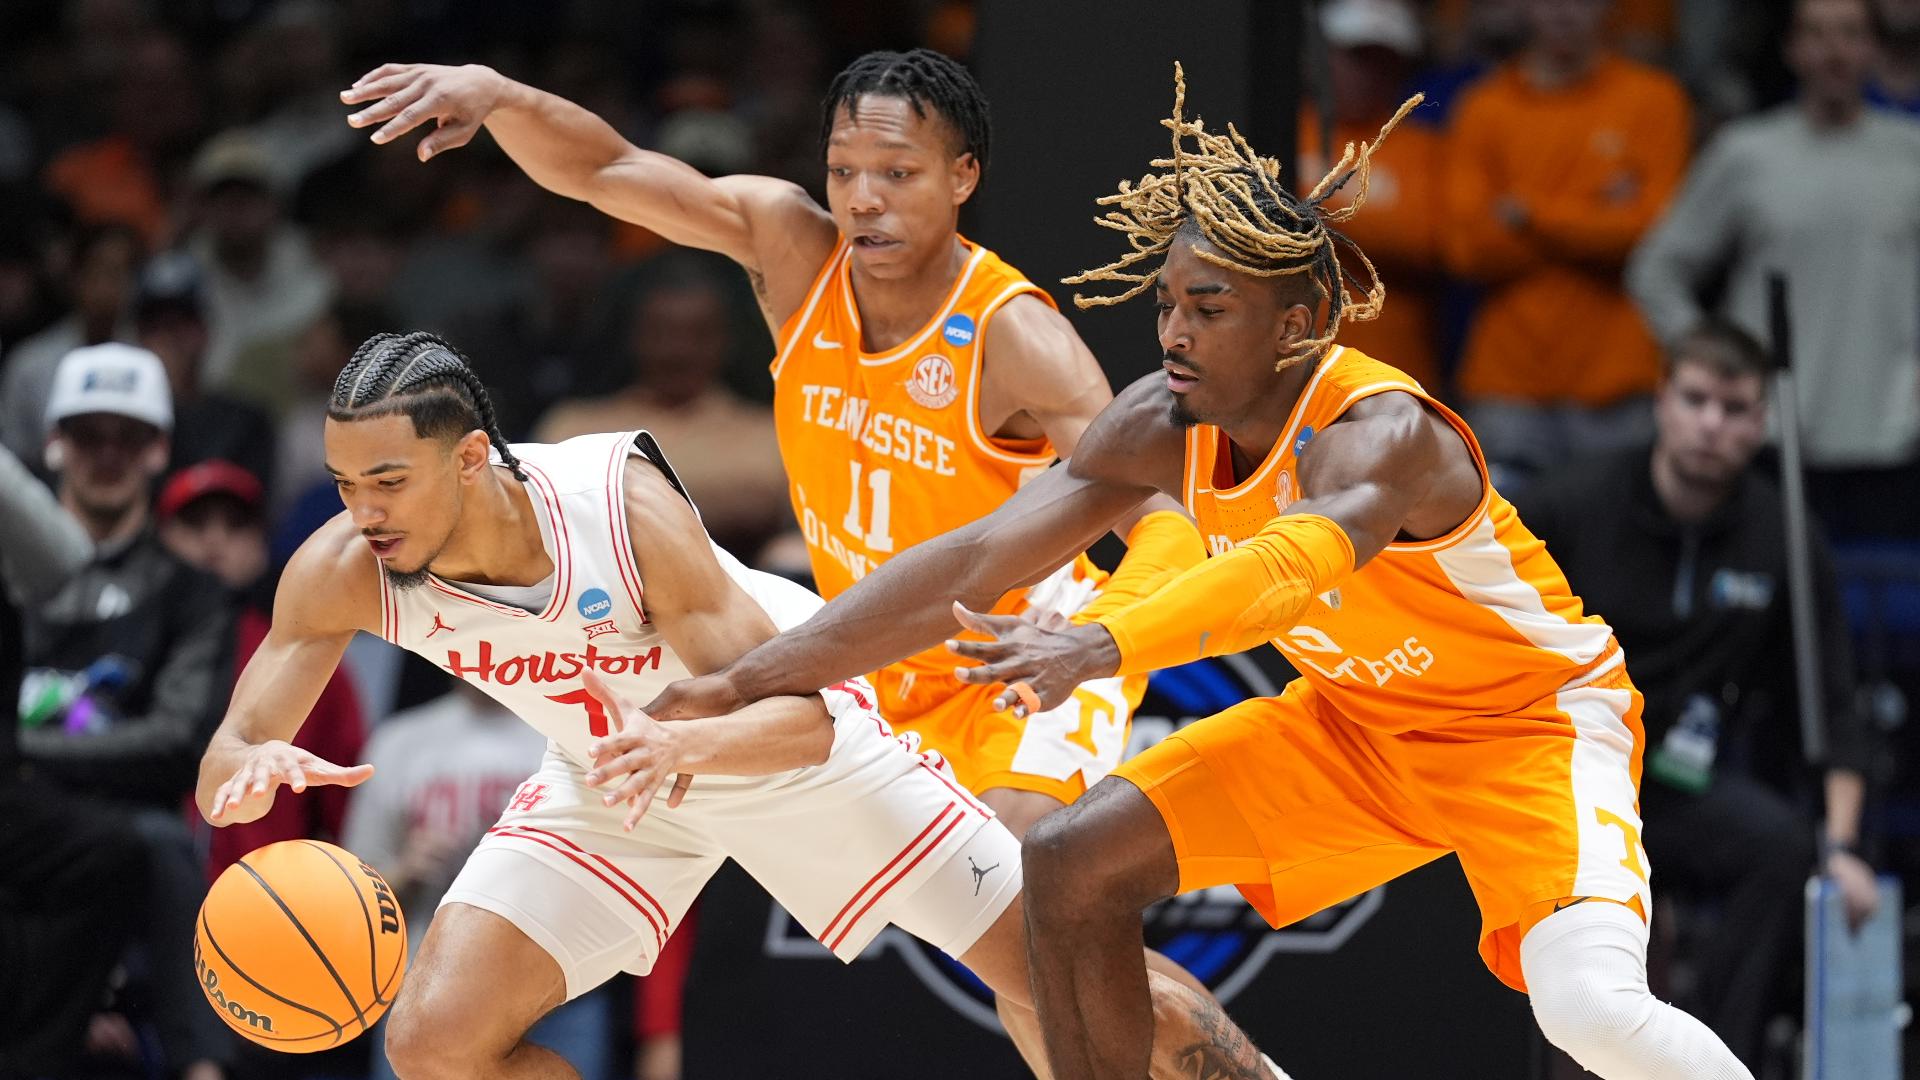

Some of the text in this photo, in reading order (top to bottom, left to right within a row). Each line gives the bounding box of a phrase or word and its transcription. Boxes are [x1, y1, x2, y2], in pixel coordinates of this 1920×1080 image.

[945, 326, 973, 342] NCAA
[916, 358, 952, 396] SEC
[843, 462, 894, 553] 11
[583, 600, 611, 616] NCAA
[442, 640, 662, 686] Houston
[1594, 806, 1648, 886] T
